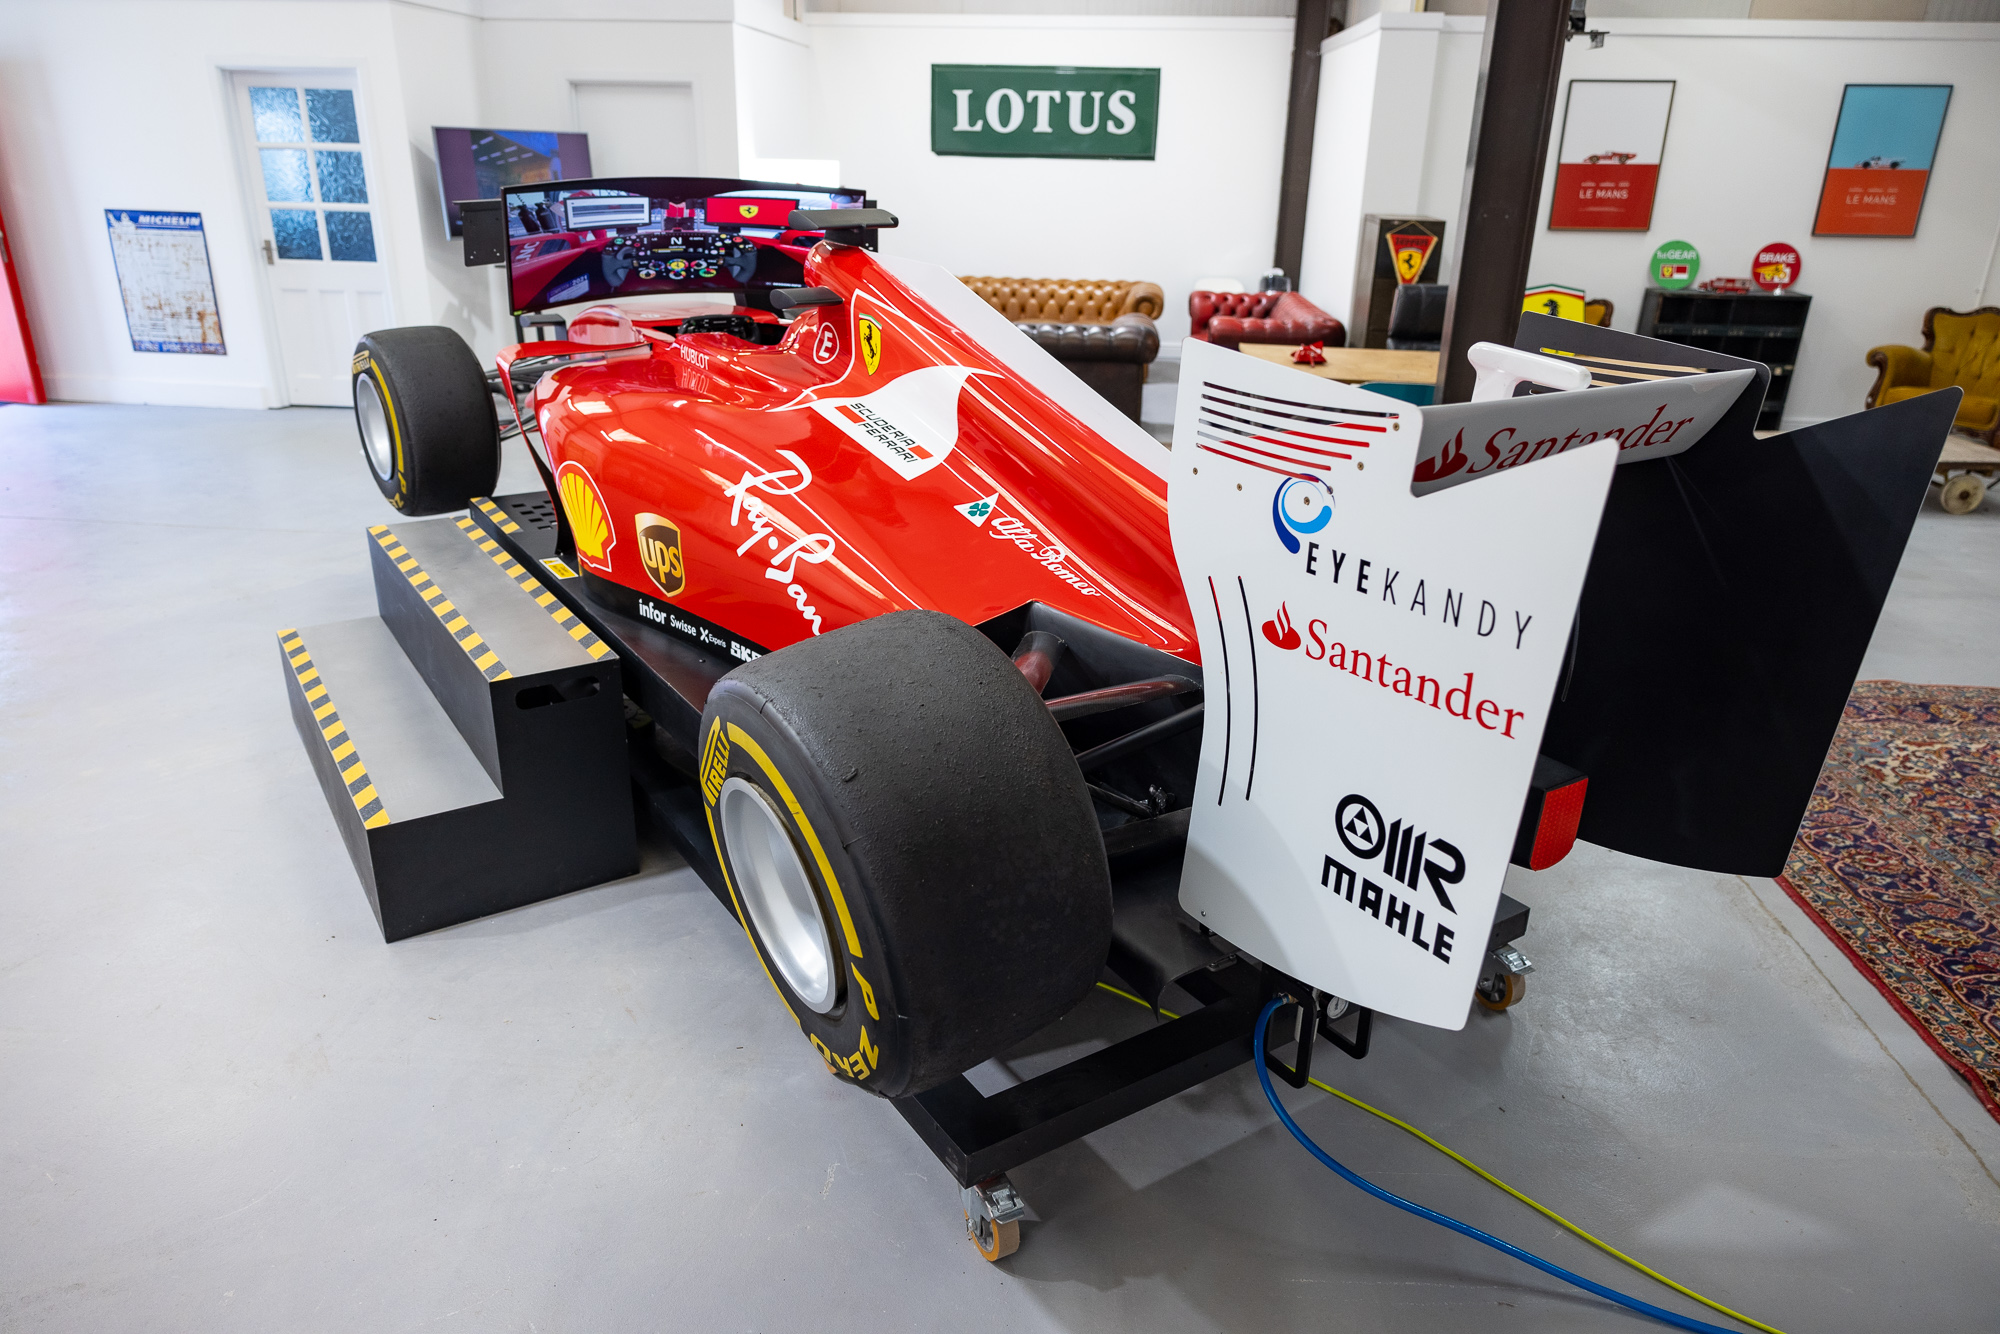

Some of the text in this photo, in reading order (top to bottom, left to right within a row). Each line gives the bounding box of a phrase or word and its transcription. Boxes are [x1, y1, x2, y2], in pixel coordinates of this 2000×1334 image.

[952, 88, 1136, 135] LOTUS
[1579, 189, 1628, 199] LE MANS
[1845, 194, 1896, 206] LE MANS
[138, 215, 201, 226] MICHELIN
[670, 237, 682, 245] N
[1667, 249, 1698, 260] GEAR
[1759, 251, 1797, 263] BRAKE
[680, 344, 710, 371] HUBLOT
[818, 330, 833, 358] E
[850, 402, 916, 447] SCUDERIA
[858, 422, 918, 463] FERRARI
[641, 535, 682, 584] ups
[988, 517, 1101, 596] Alfa Romeo
[1305, 541, 1533, 650] EYEKANDY
[638, 598, 667, 625] infor
[670, 614, 697, 636] Swisse
[709, 633, 727, 648] Experis
[1305, 618, 1525, 740] Santander
[1320, 854, 1455, 965] MAHLE
[850, 961, 880, 1021] P
